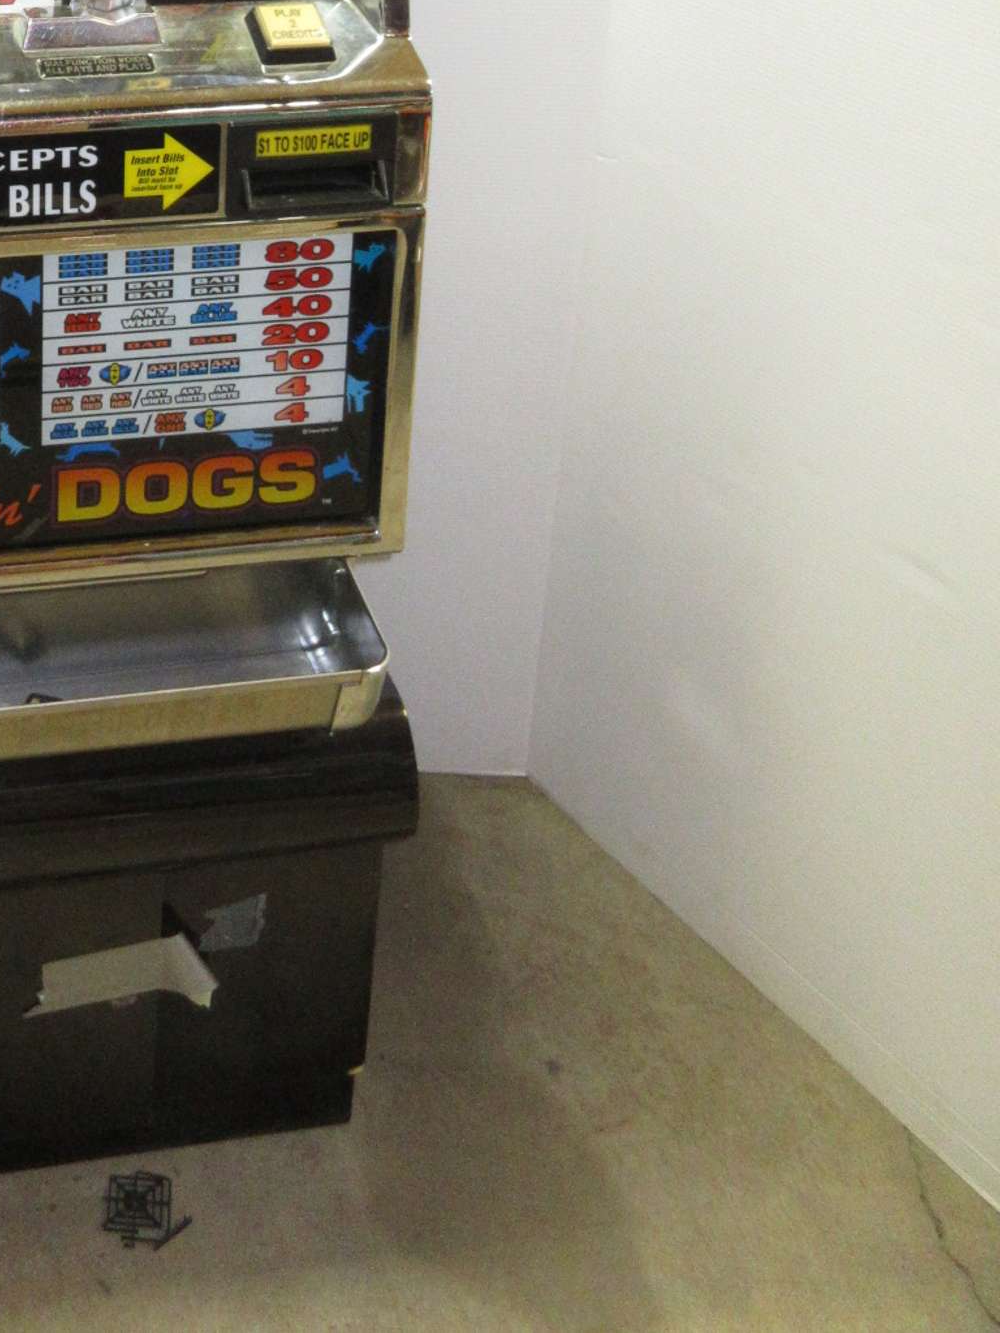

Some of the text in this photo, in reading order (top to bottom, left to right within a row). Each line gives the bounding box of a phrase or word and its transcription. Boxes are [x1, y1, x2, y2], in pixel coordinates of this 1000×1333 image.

[258, 132, 369, 152] $1 TO $100 FACE UP
[130, 153, 185, 165] Insert Bills
[136, 165, 179, 177] Into Slot
[8, 179, 98, 217] BILLS
[265, 238, 335, 263] 80
[264, 266, 333, 291] 50
[131, 307, 169, 319] ANY
[262, 294, 332, 318] 40
[121, 316, 176, 329] WHITE
[262, 321, 329, 346] 20
[266, 348, 324, 372] 10
[276, 376, 310, 396] 4
[275, 402, 309, 423] 4
[57, 448, 316, 523] DOGS
